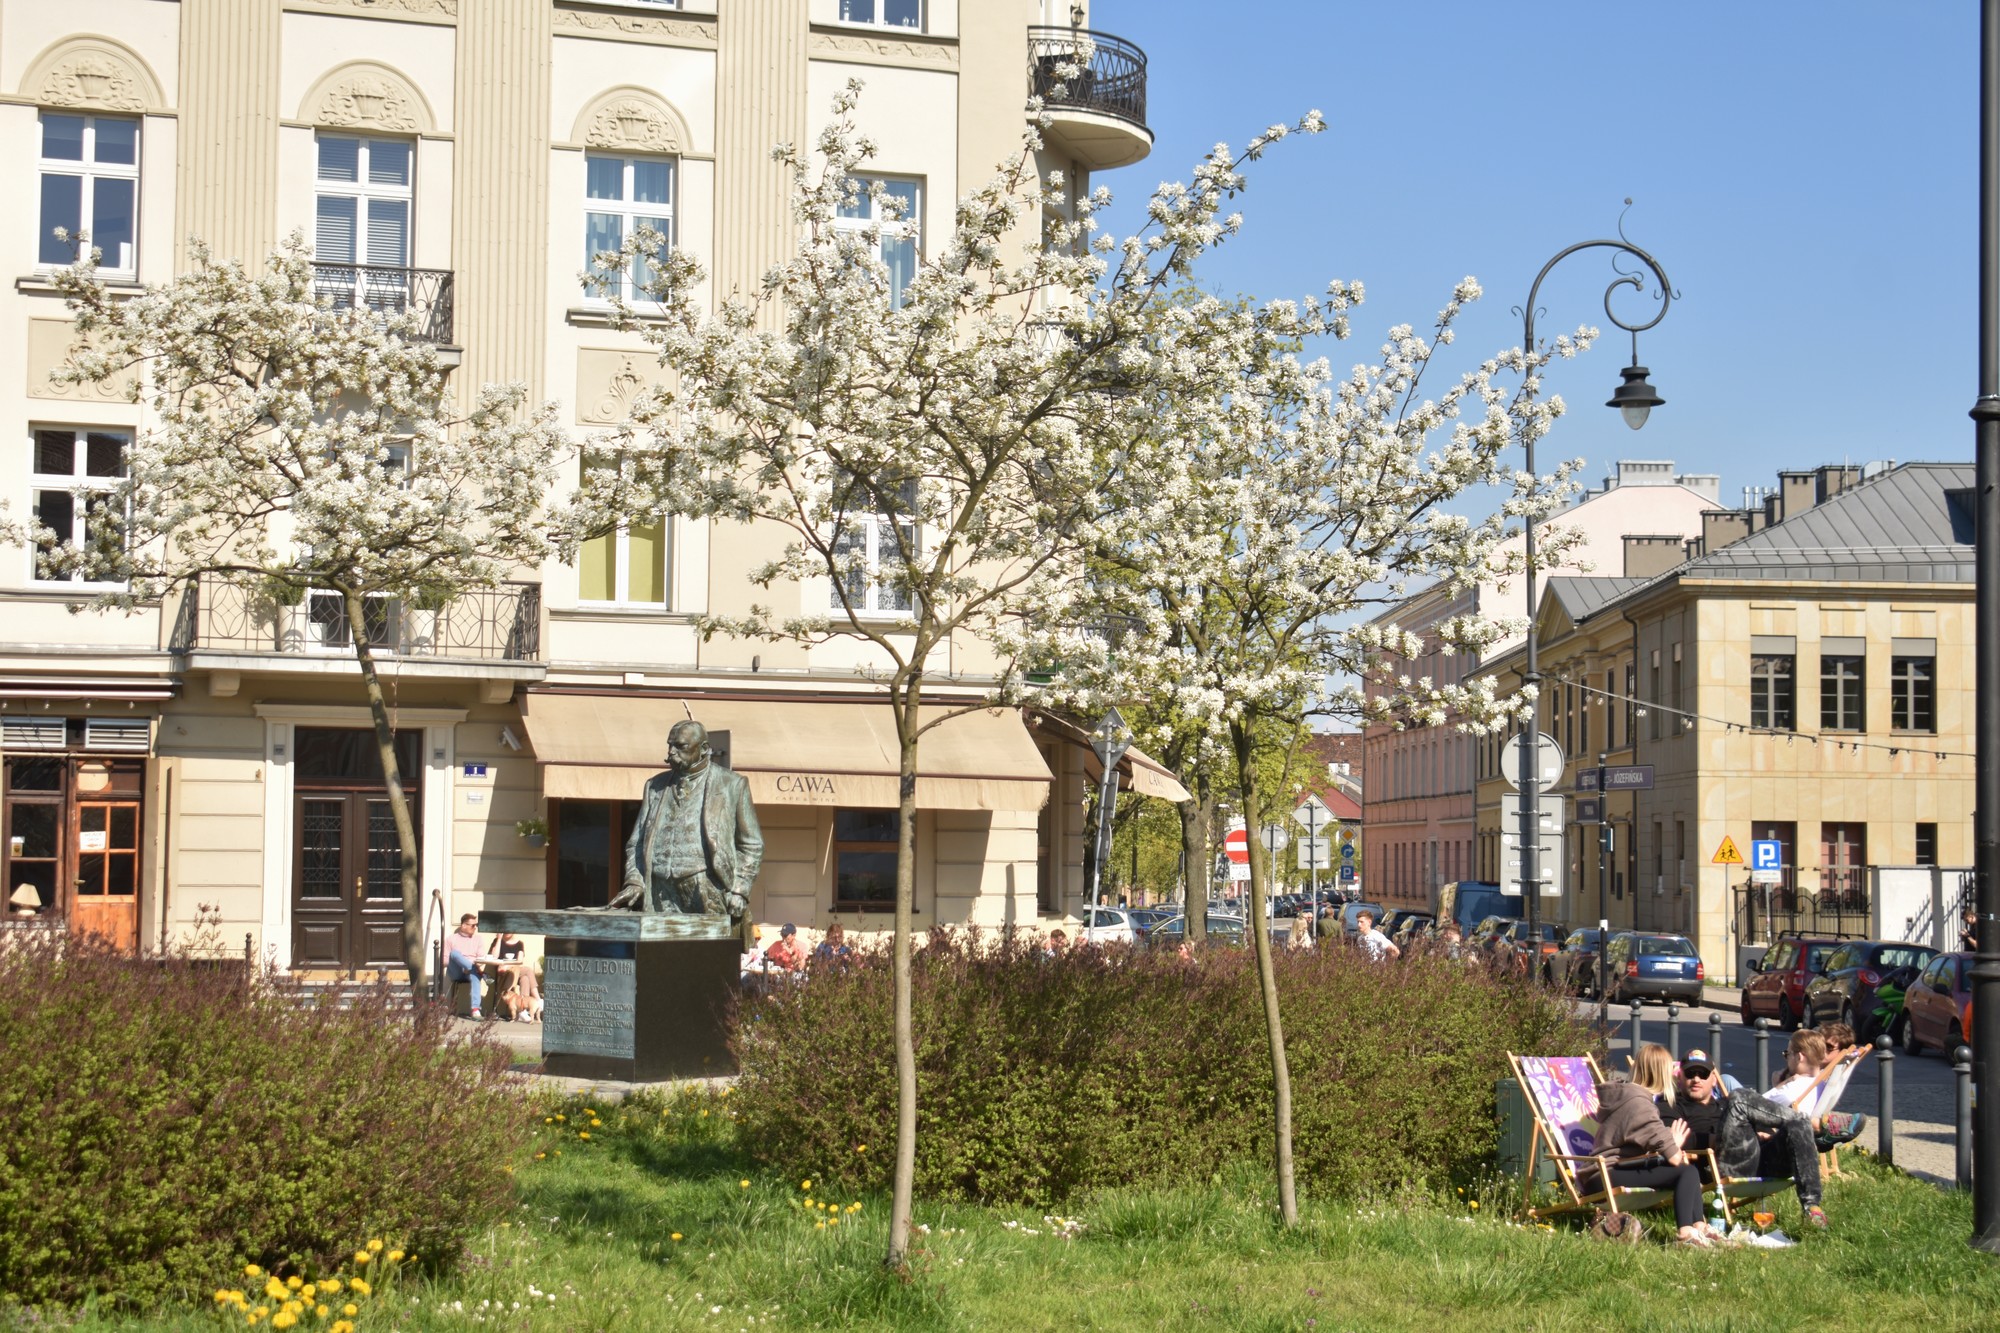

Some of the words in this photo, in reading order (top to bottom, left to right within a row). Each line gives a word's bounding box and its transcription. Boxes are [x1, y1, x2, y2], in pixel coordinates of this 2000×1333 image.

[776, 775, 836, 793] CAWA
[1613, 770, 1644, 784] JÓZEFIŃSKA
[1758, 843, 1775, 867] P
[1343, 867, 1351, 878] P
[545, 958, 590, 975] JULIUSZ
[595, 960, 618, 975] LEO
